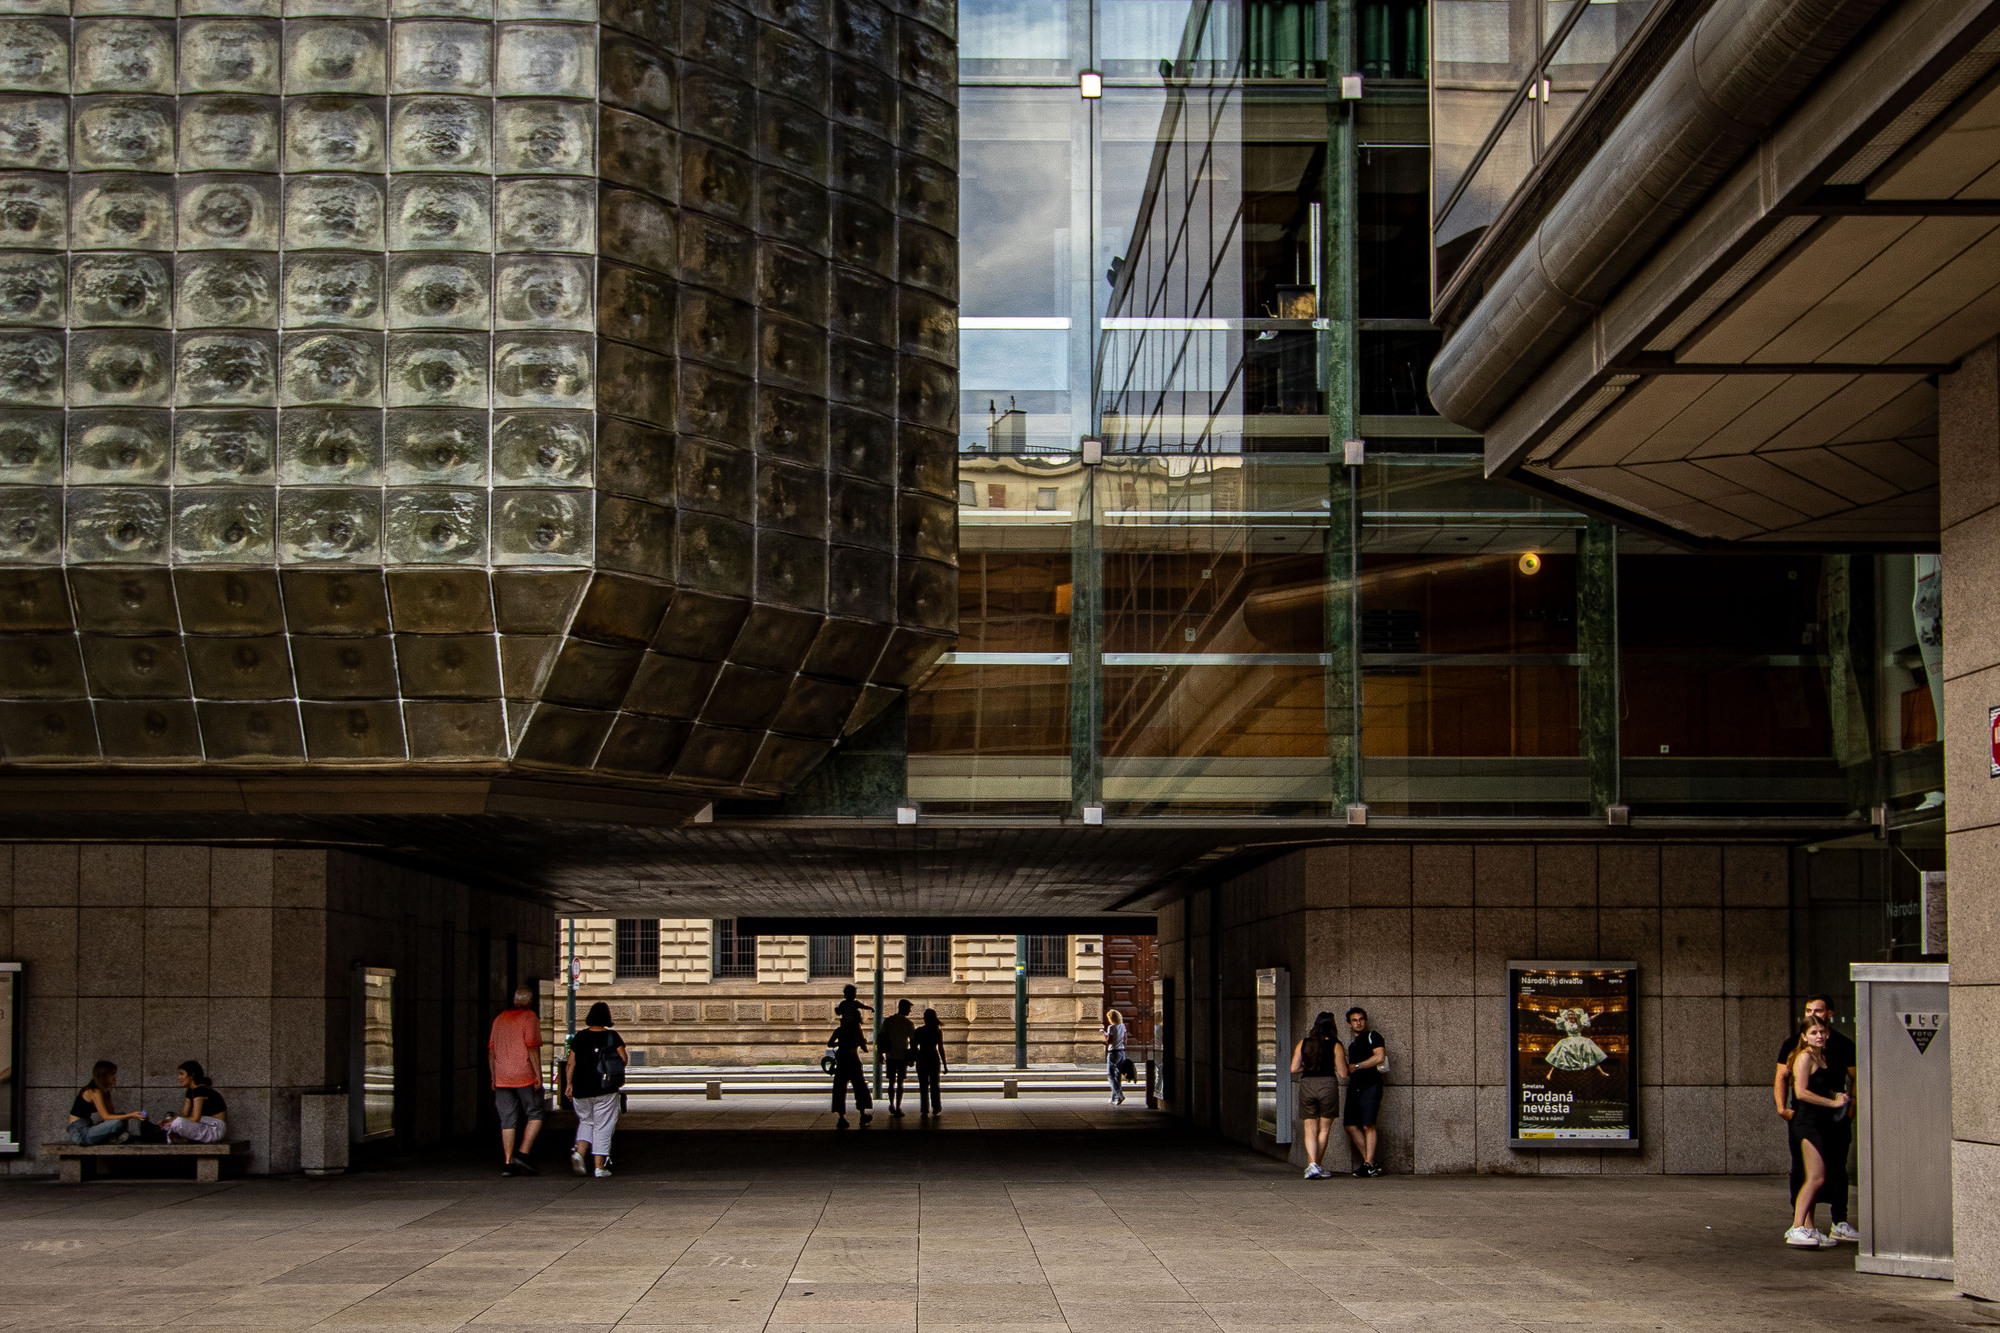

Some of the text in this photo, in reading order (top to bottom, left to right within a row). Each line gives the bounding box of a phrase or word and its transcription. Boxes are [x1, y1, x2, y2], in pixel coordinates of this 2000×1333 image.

[1521, 976, 1583, 985] Národní divadlo
[1523, 1090, 1573, 1102] Prodaná
[1523, 1102, 1570, 1113] nevěsta
